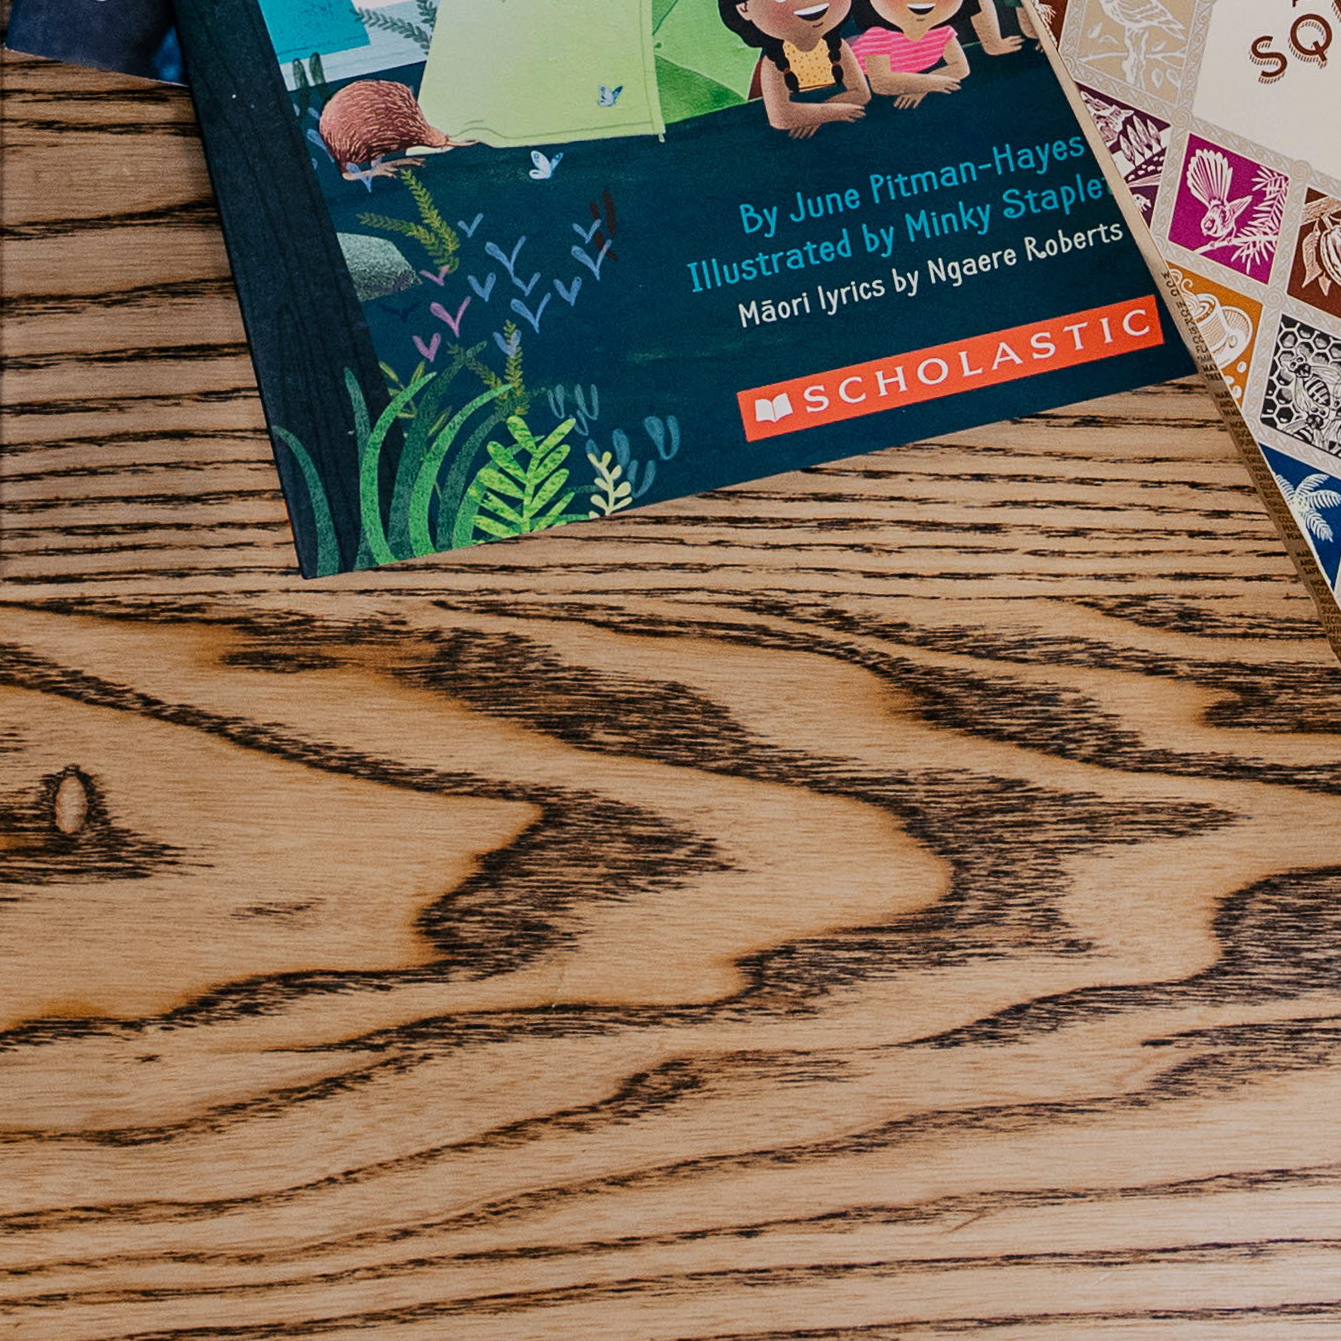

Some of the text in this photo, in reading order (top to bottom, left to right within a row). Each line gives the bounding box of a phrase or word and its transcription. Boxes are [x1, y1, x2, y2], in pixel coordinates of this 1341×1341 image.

[739, 135, 1087, 239] By June Pitman-Hayes
[687, 200, 992, 293] Illustrated by Minky
[739, 221, 1124, 328] Māori lyrics by Ngaere Roberts
[803, 309, 1151, 413] SCHOLASTIC
